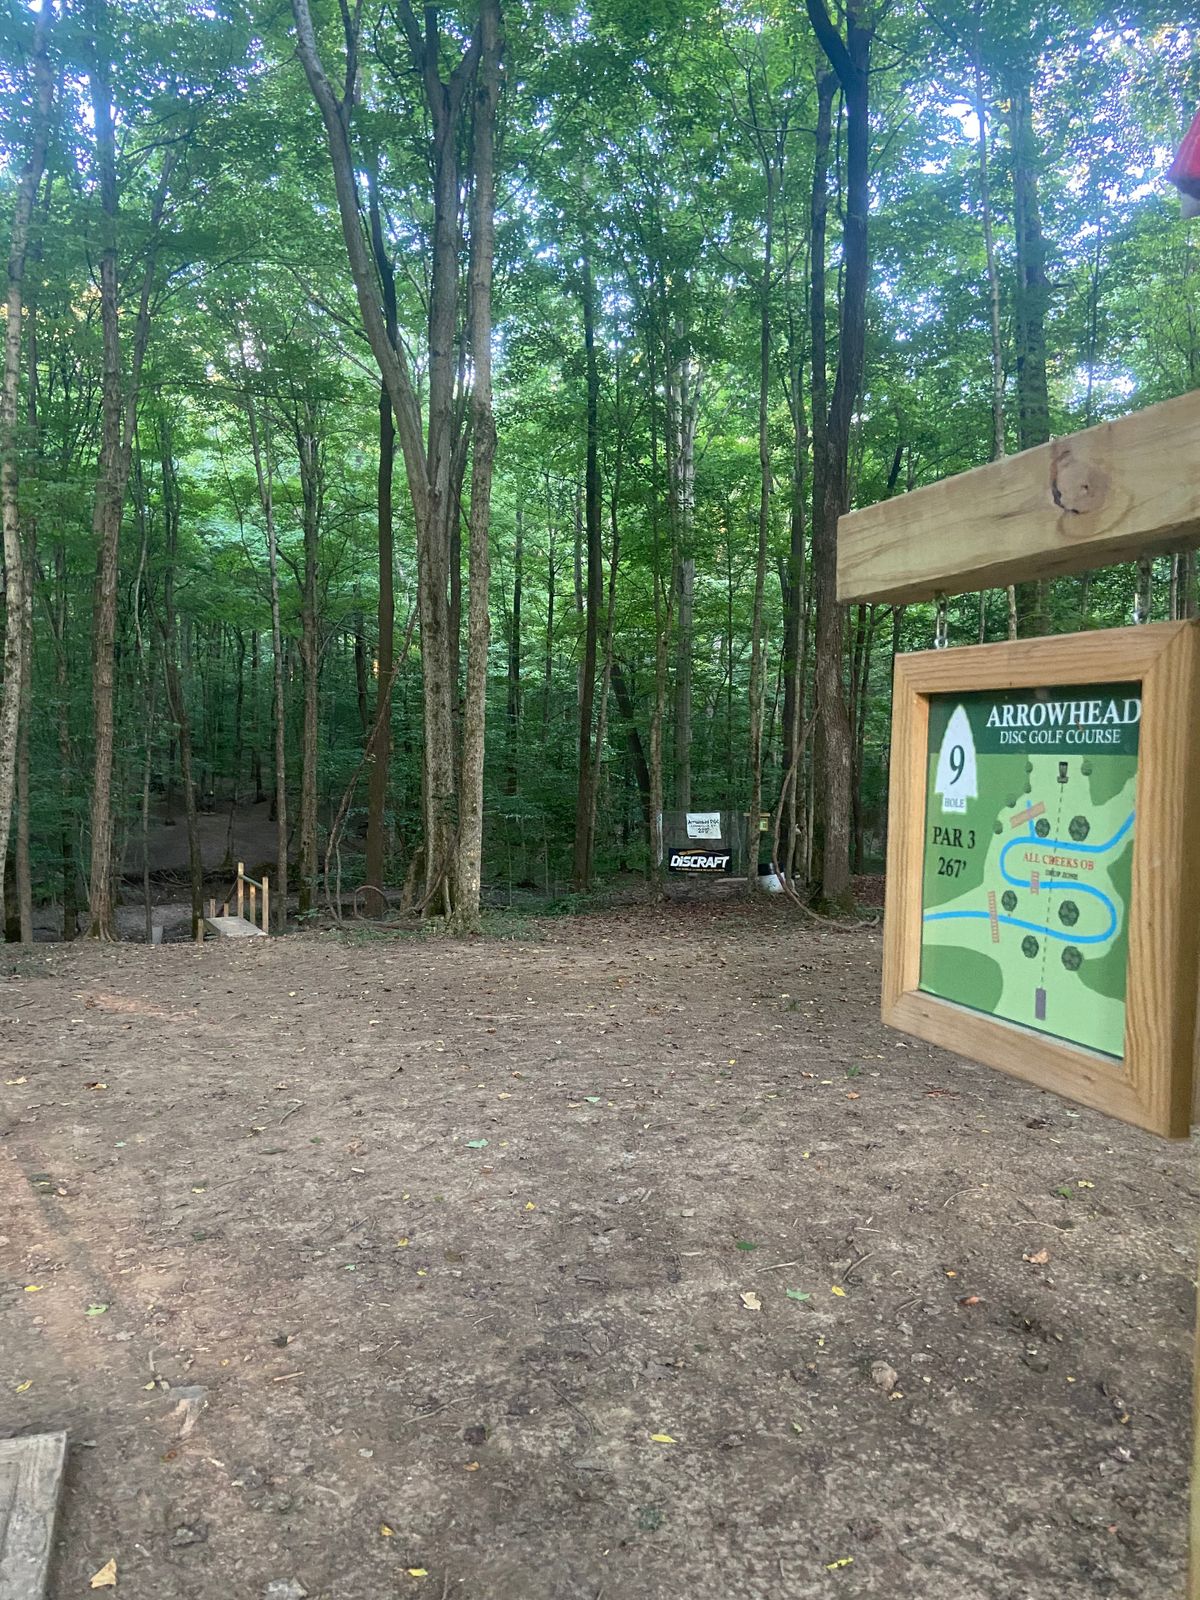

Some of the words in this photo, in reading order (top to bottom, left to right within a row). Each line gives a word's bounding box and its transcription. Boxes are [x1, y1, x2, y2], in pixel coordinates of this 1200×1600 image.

[986, 699, 1141, 727] ARROWHEAD
[1000, 731, 1027, 744] DISC
[1028, 730, 1063, 744] GOLF
[1065, 729, 1121, 744] COURSE
[949, 744, 965, 785] 9
[944, 798, 966, 808] HOLE
[932, 826, 964, 848] PAR
[967, 829, 976, 849] 3
[1024, 852, 1040, 863] ALL
[1042, 854, 1079, 869] CREEKS
[1080, 859, 1095, 871] OB
